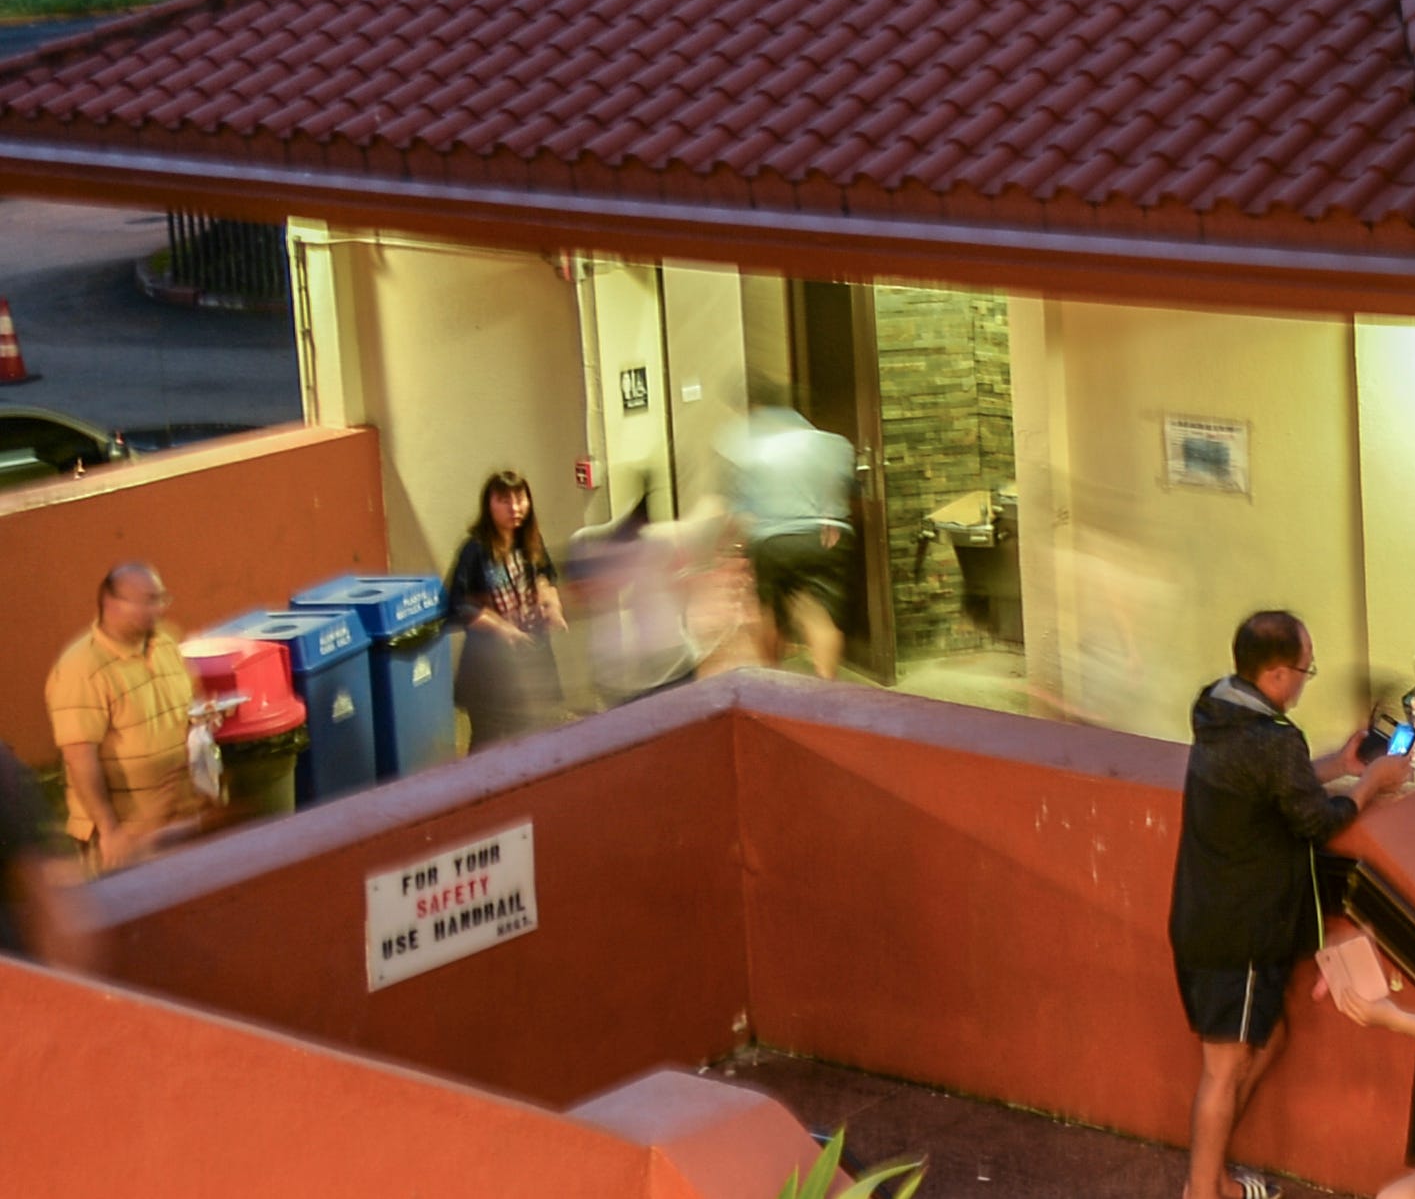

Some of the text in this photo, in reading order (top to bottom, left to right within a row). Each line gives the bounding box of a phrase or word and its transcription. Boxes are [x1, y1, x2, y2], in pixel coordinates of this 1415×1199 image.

[402, 844, 500, 896] FOR YOUR
[416, 876, 489, 919] SAFETY
[382, 890, 525, 960] USE HANDRAIL
